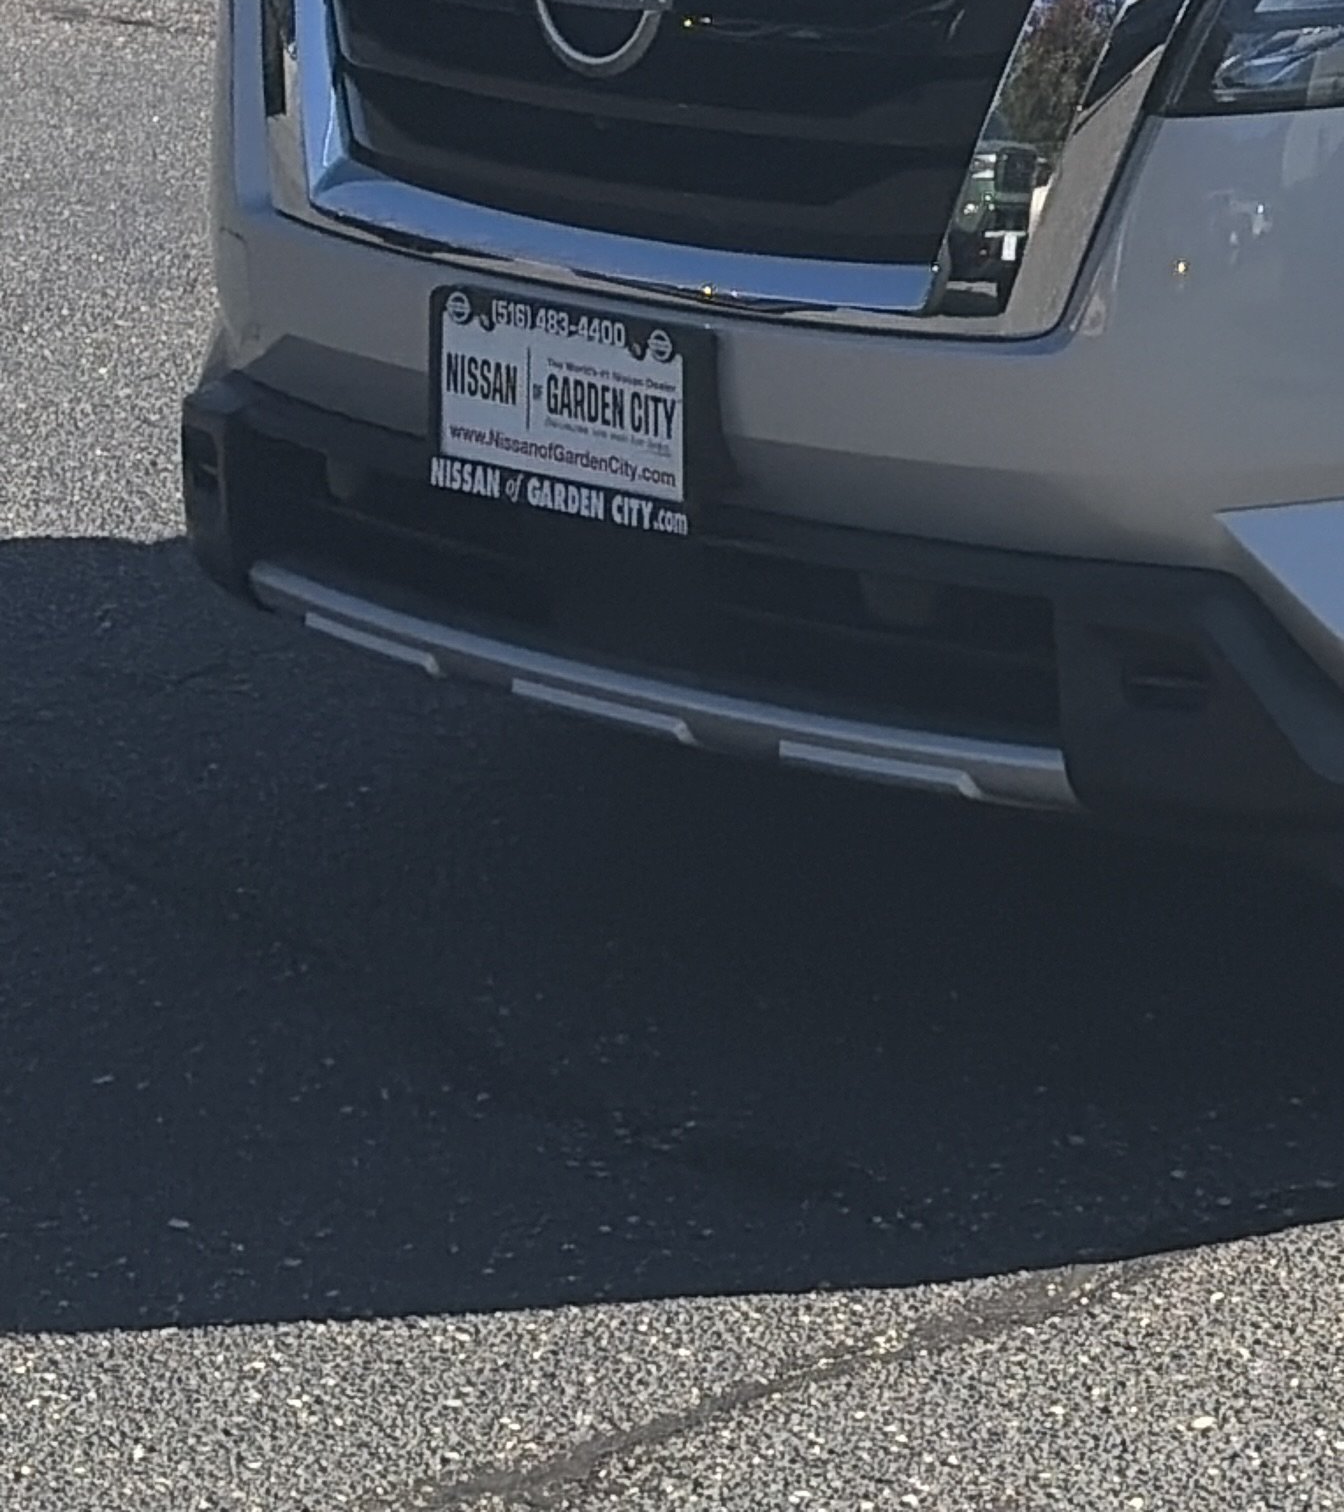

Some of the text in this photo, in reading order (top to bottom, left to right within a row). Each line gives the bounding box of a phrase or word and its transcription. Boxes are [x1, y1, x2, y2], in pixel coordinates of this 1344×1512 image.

[491, 299, 626, 347] (516) 483-4400
[445, 352, 518, 406] NISSAN
[546, 372, 625, 430] GARDEN
[630, 390, 676, 440] CITY
[430, 456, 501, 499] NISSAN
[504, 473, 525, 503] of
[526, 477, 605, 522] GARDEN
[449, 423, 677, 489] www.NissanofGardenCity.com
